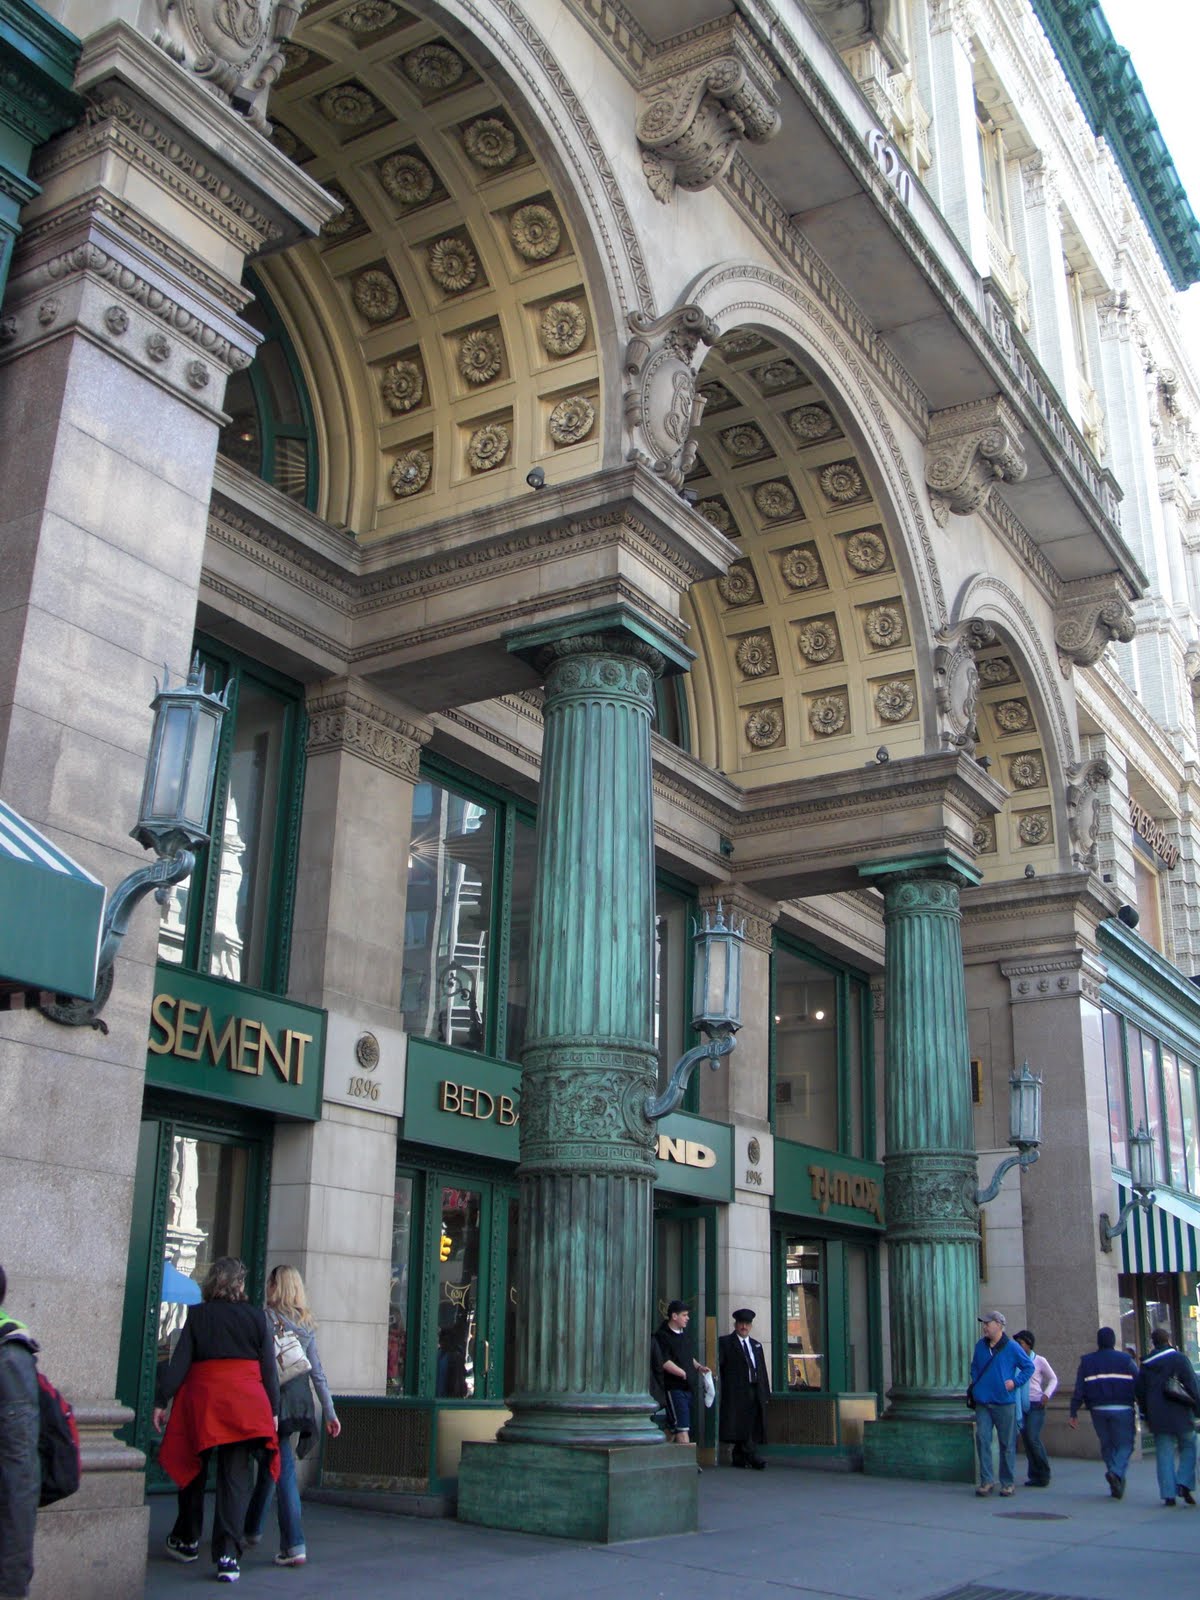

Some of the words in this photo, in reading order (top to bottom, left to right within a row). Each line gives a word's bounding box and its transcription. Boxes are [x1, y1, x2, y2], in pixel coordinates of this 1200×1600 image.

[148, 993, 313, 1085] SEMENT
[347, 1077, 381, 1101] 1896
[440, 1080, 495, 1120] BED
[655, 1134, 717, 1168] ND
